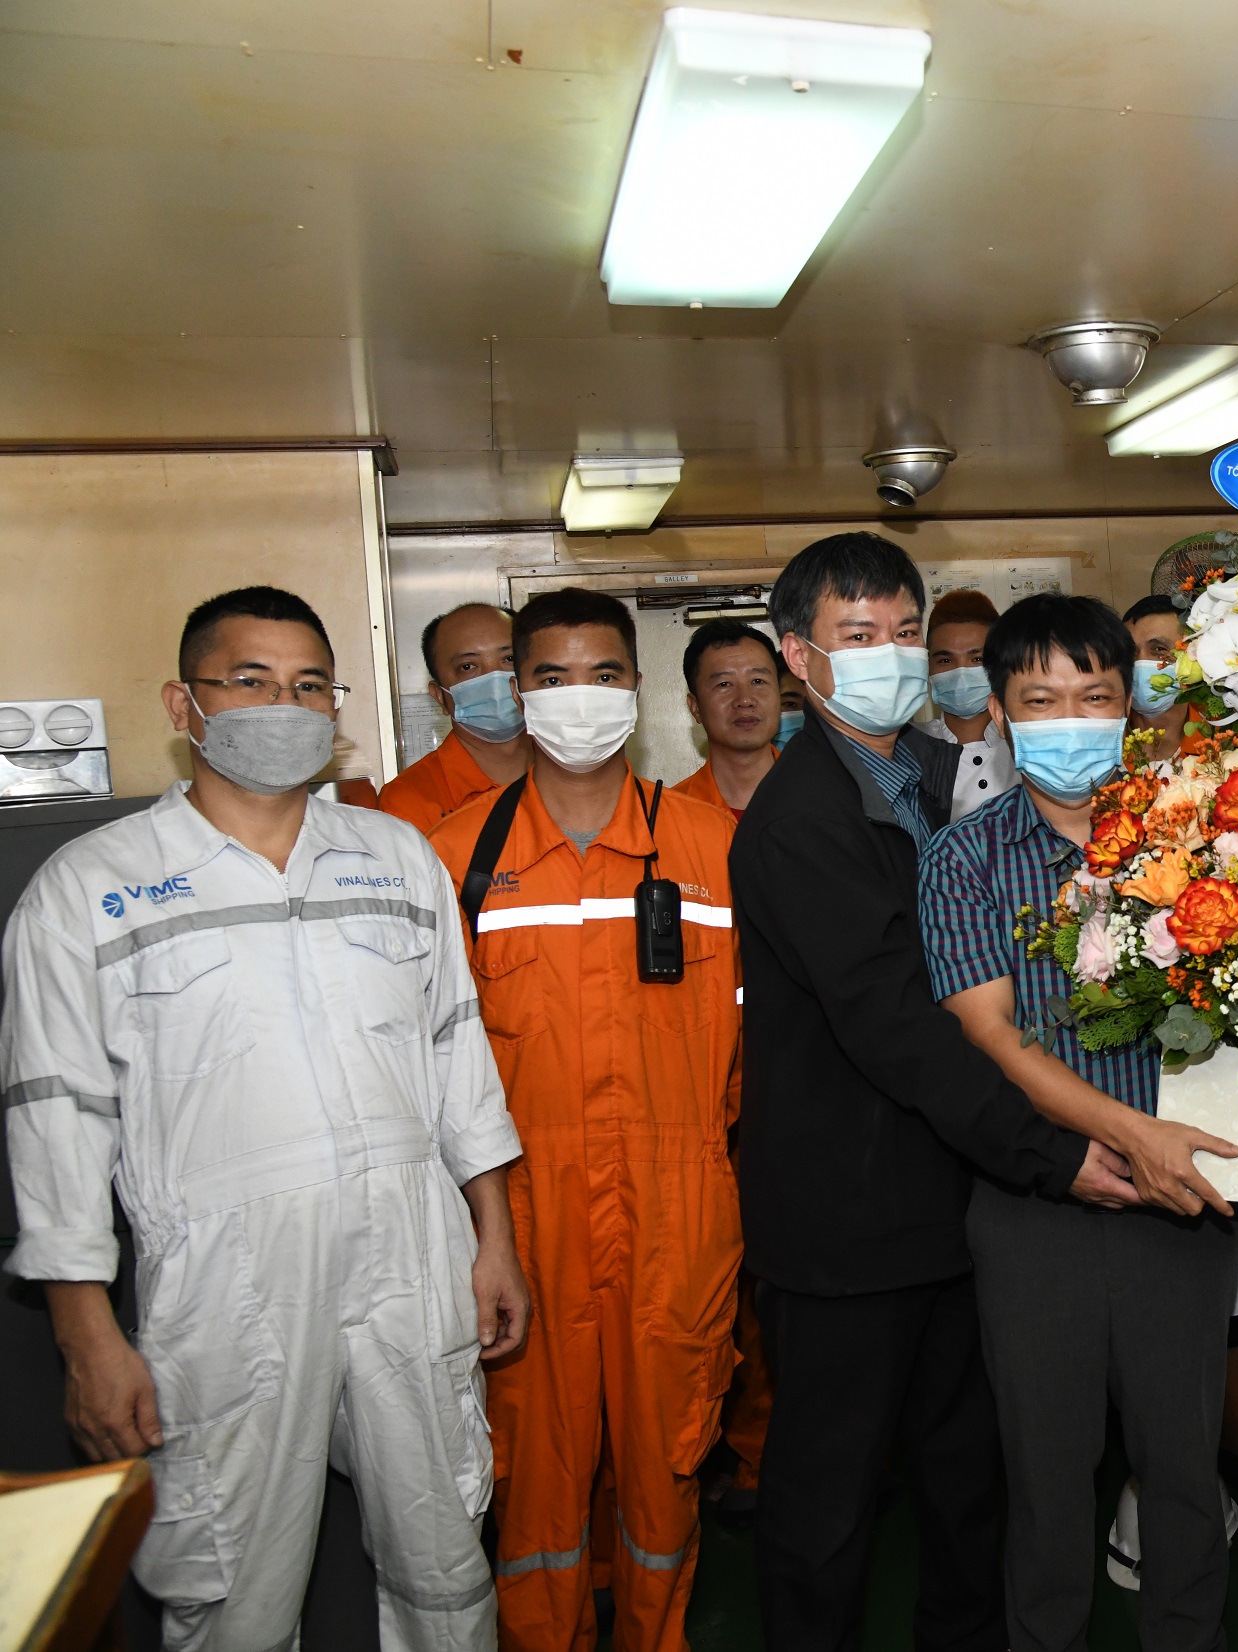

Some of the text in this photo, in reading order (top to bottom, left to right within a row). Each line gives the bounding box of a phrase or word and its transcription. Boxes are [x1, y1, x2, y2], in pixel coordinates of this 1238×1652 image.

[664, 575, 689, 583] GALLEY
[334, 875, 391, 888] VINALINES
[490, 870, 519, 887] MC
[123, 877, 192, 899] VIMC
[489, 884, 520, 896] HIPPING
[679, 882, 699, 896] INES
[151, 890, 196, 906] SHIPPING
